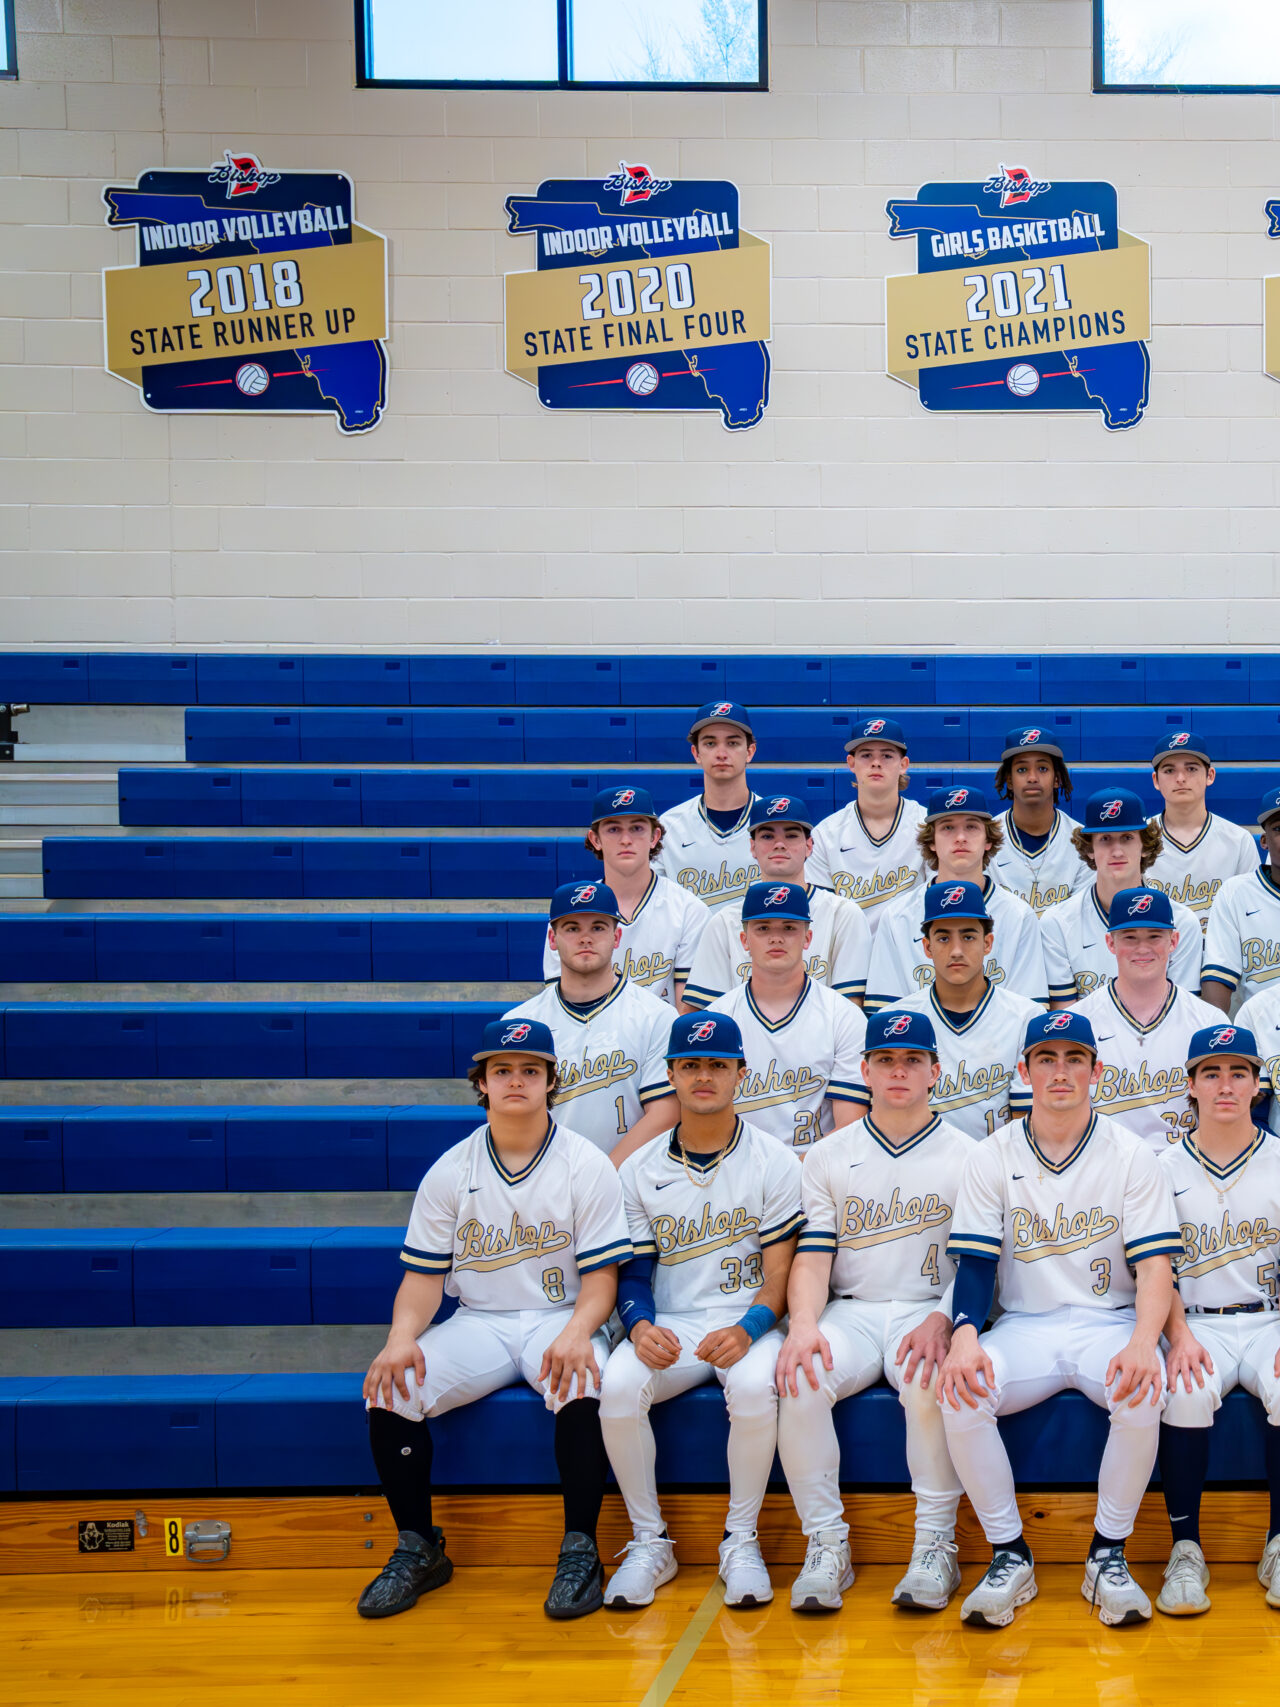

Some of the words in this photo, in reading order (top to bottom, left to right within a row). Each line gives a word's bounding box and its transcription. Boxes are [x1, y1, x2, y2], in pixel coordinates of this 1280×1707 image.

[209, 166, 280, 184] Bishop
[605, 174, 671, 193] Bishop
[984, 176, 1051, 196] Bishop
[143, 220, 220, 251] INDOOR
[222, 205, 348, 241] VOLLEYBALL
[542, 226, 614, 256] INDOOR
[616, 212, 734, 247] VOLLEYBALL
[930, 230, 985, 258] GIRLS
[986, 214, 1105, 250] BASKETBALL
[187, 260, 303, 318] 2018
[579, 263, 695, 320] 2020
[963, 264, 1072, 322] 2021
[130, 324, 203, 355] STATE
[214, 312, 315, 347] RUNNER
[326, 307, 356, 334] UP
[524, 326, 593, 357] STATE
[603, 318, 674, 348] FINAL
[683, 309, 747, 339] FOUR
[905, 328, 974, 359] STATE
[984, 309, 1126, 350] CHAMPIONS
[833, 865, 918, 902] Bishop
[556, 1045, 638, 1089] ishop
[733, 1058, 826, 1102] ishop
[928, 1059, 1013, 1100] ishop
[1091, 1060, 1191, 1104] Bishop
[614, 1096, 627, 1134] 1
[793, 1109, 824, 1146] 21
[651, 1202, 761, 1254] Bishop
[839, 1187, 952, 1238] Bishop
[1010, 1203, 1119, 1250] Bishop
[454, 1211, 571, 1262] Bishop
[1176, 1210, 1280, 1268] Bishop
[542, 1266, 565, 1303] 8
[720, 1252, 764, 1294] 33
[921, 1244, 940, 1286] 4
[1090, 1257, 1111, 1297] 3
[168, 1520, 180, 1554] 8
